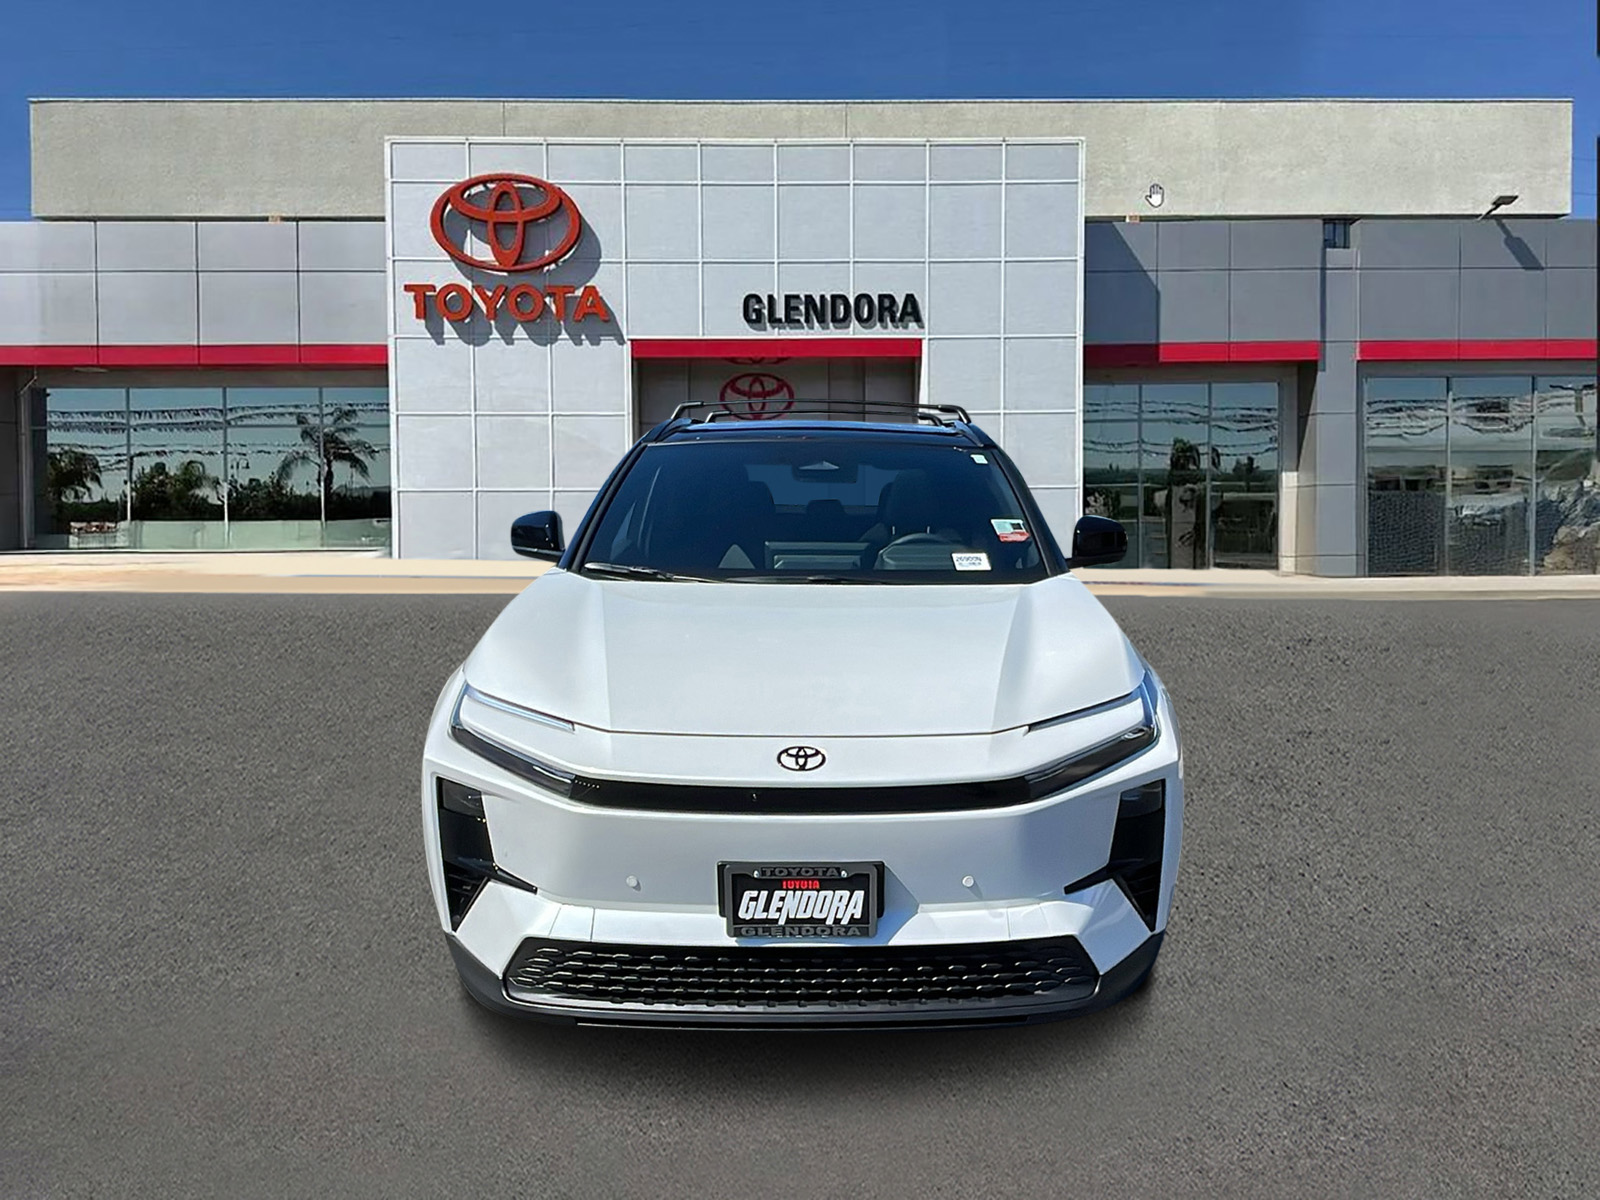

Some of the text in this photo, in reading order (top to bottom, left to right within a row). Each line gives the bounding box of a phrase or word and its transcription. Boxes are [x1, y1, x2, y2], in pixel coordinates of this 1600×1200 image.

[404, 282, 609, 322] TOYOTA
[743, 293, 921, 324] GLENDORA
[762, 867, 839, 877] TOYOTA
[782, 880, 820, 889] TOYOTA
[738, 890, 865, 925] GLENDORA
[741, 926, 861, 936] GLENDORA
